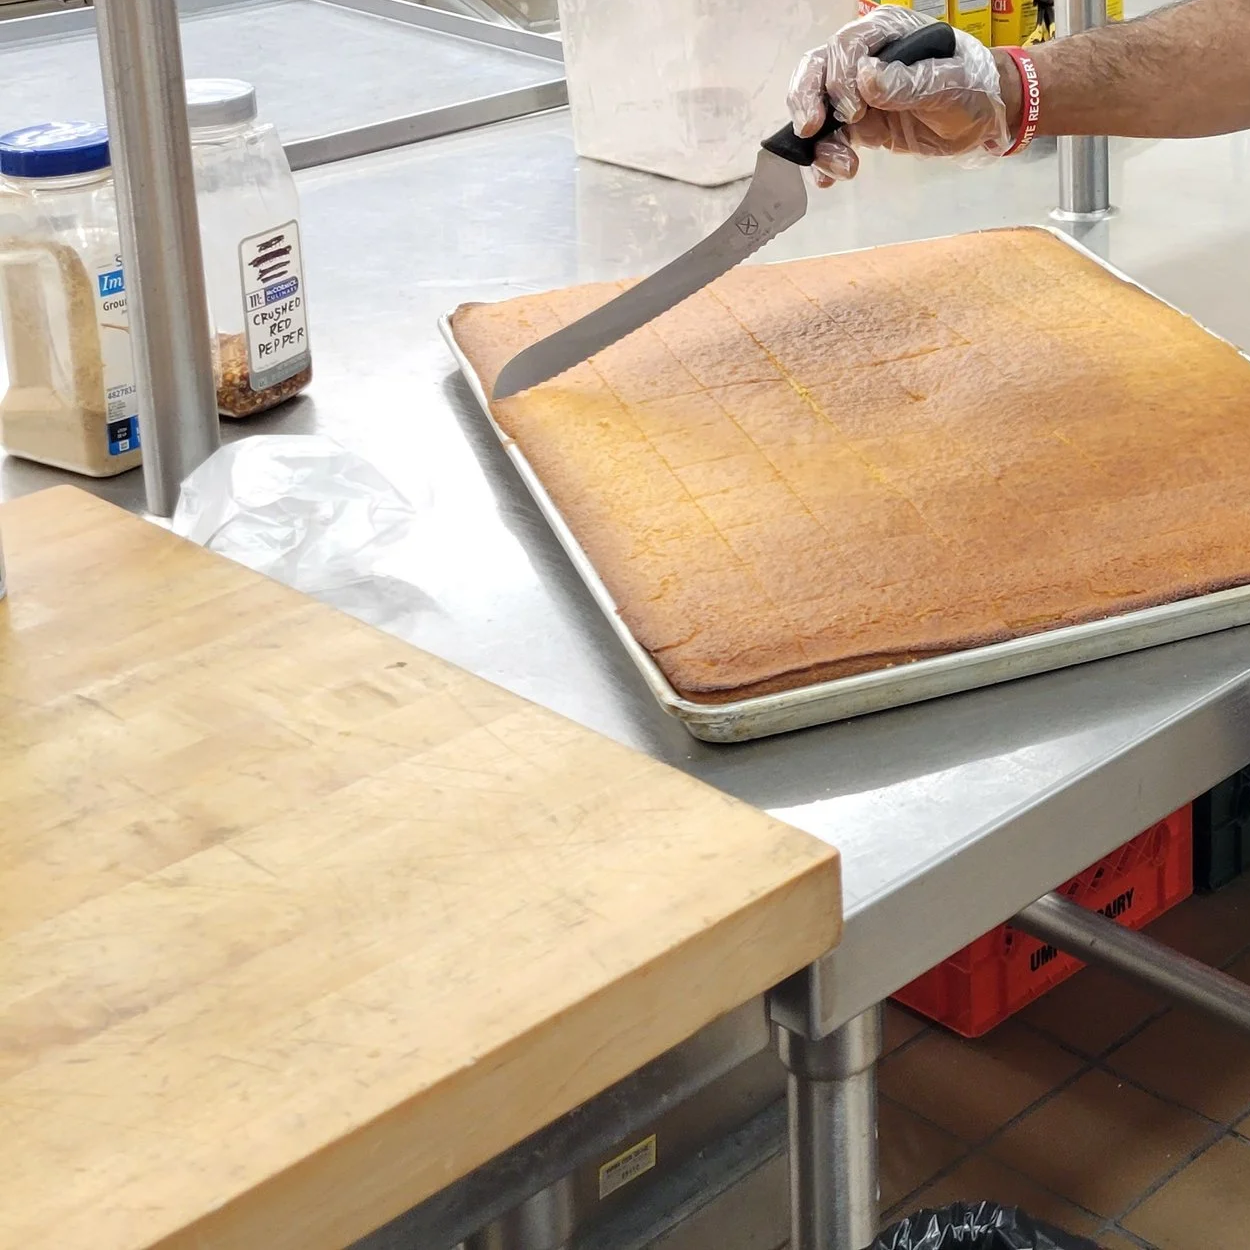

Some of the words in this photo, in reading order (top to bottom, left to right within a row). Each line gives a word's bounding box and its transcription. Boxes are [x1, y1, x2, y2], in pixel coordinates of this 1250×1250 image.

[1020, 57, 1040, 122] RECOVERY
[103, 299, 128, 311] Grou
[253, 297, 301, 326] CRUSHED
[269, 318, 292, 337] RED
[258, 327, 305, 359] PEPPER
